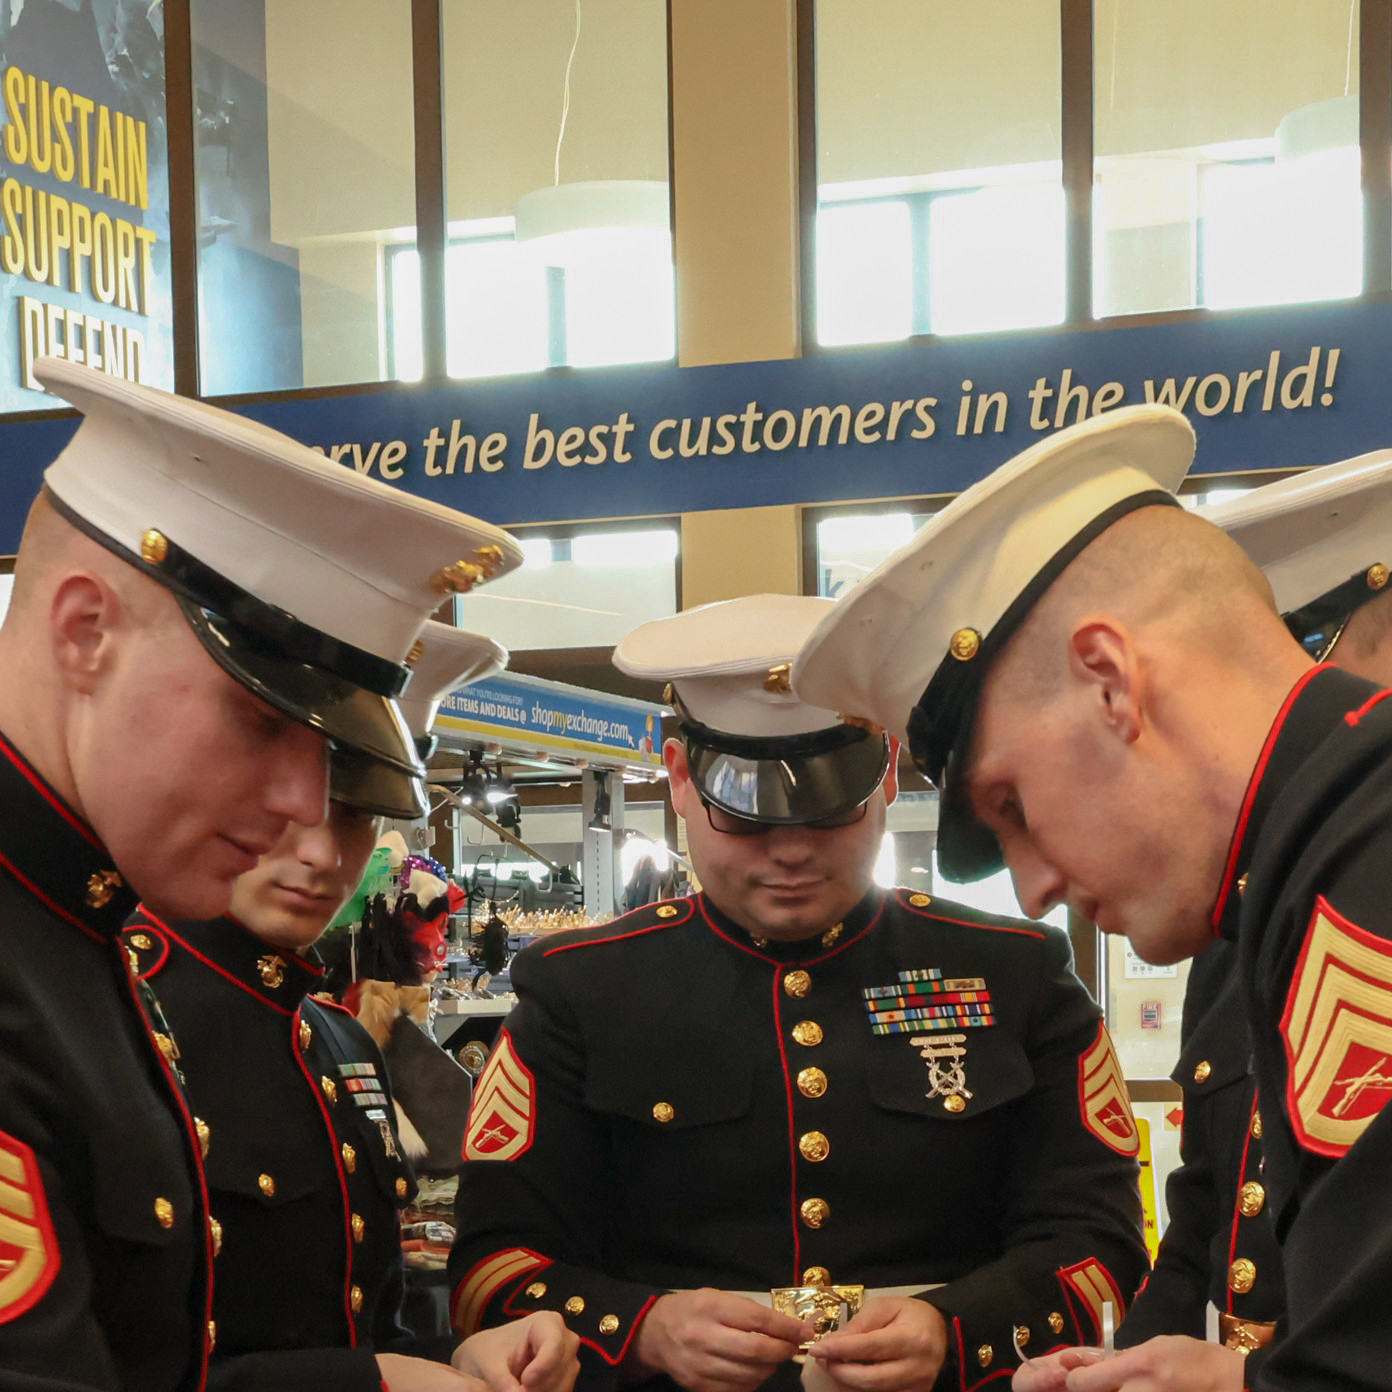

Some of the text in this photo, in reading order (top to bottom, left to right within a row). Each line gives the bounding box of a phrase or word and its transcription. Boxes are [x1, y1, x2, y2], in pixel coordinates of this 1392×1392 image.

[3, 66, 149, 211] SUSTAIN
[0, 177, 157, 317] SUPPORT
[423, 419, 508, 477] the
[522, 412, 635, 470] best
[648, 395, 938, 460] customers
[956, 379, 1008, 437] in
[1028, 369, 1125, 431] the
[1143, 346, 1341, 417] world!
[456, 699, 480, 716] ITEMS
[480, 702, 497, 718] AND
[497, 704, 520, 723] DEALS
[520, 710, 527, 725] @
[531, 701, 629, 742] shopmyexchange.com
